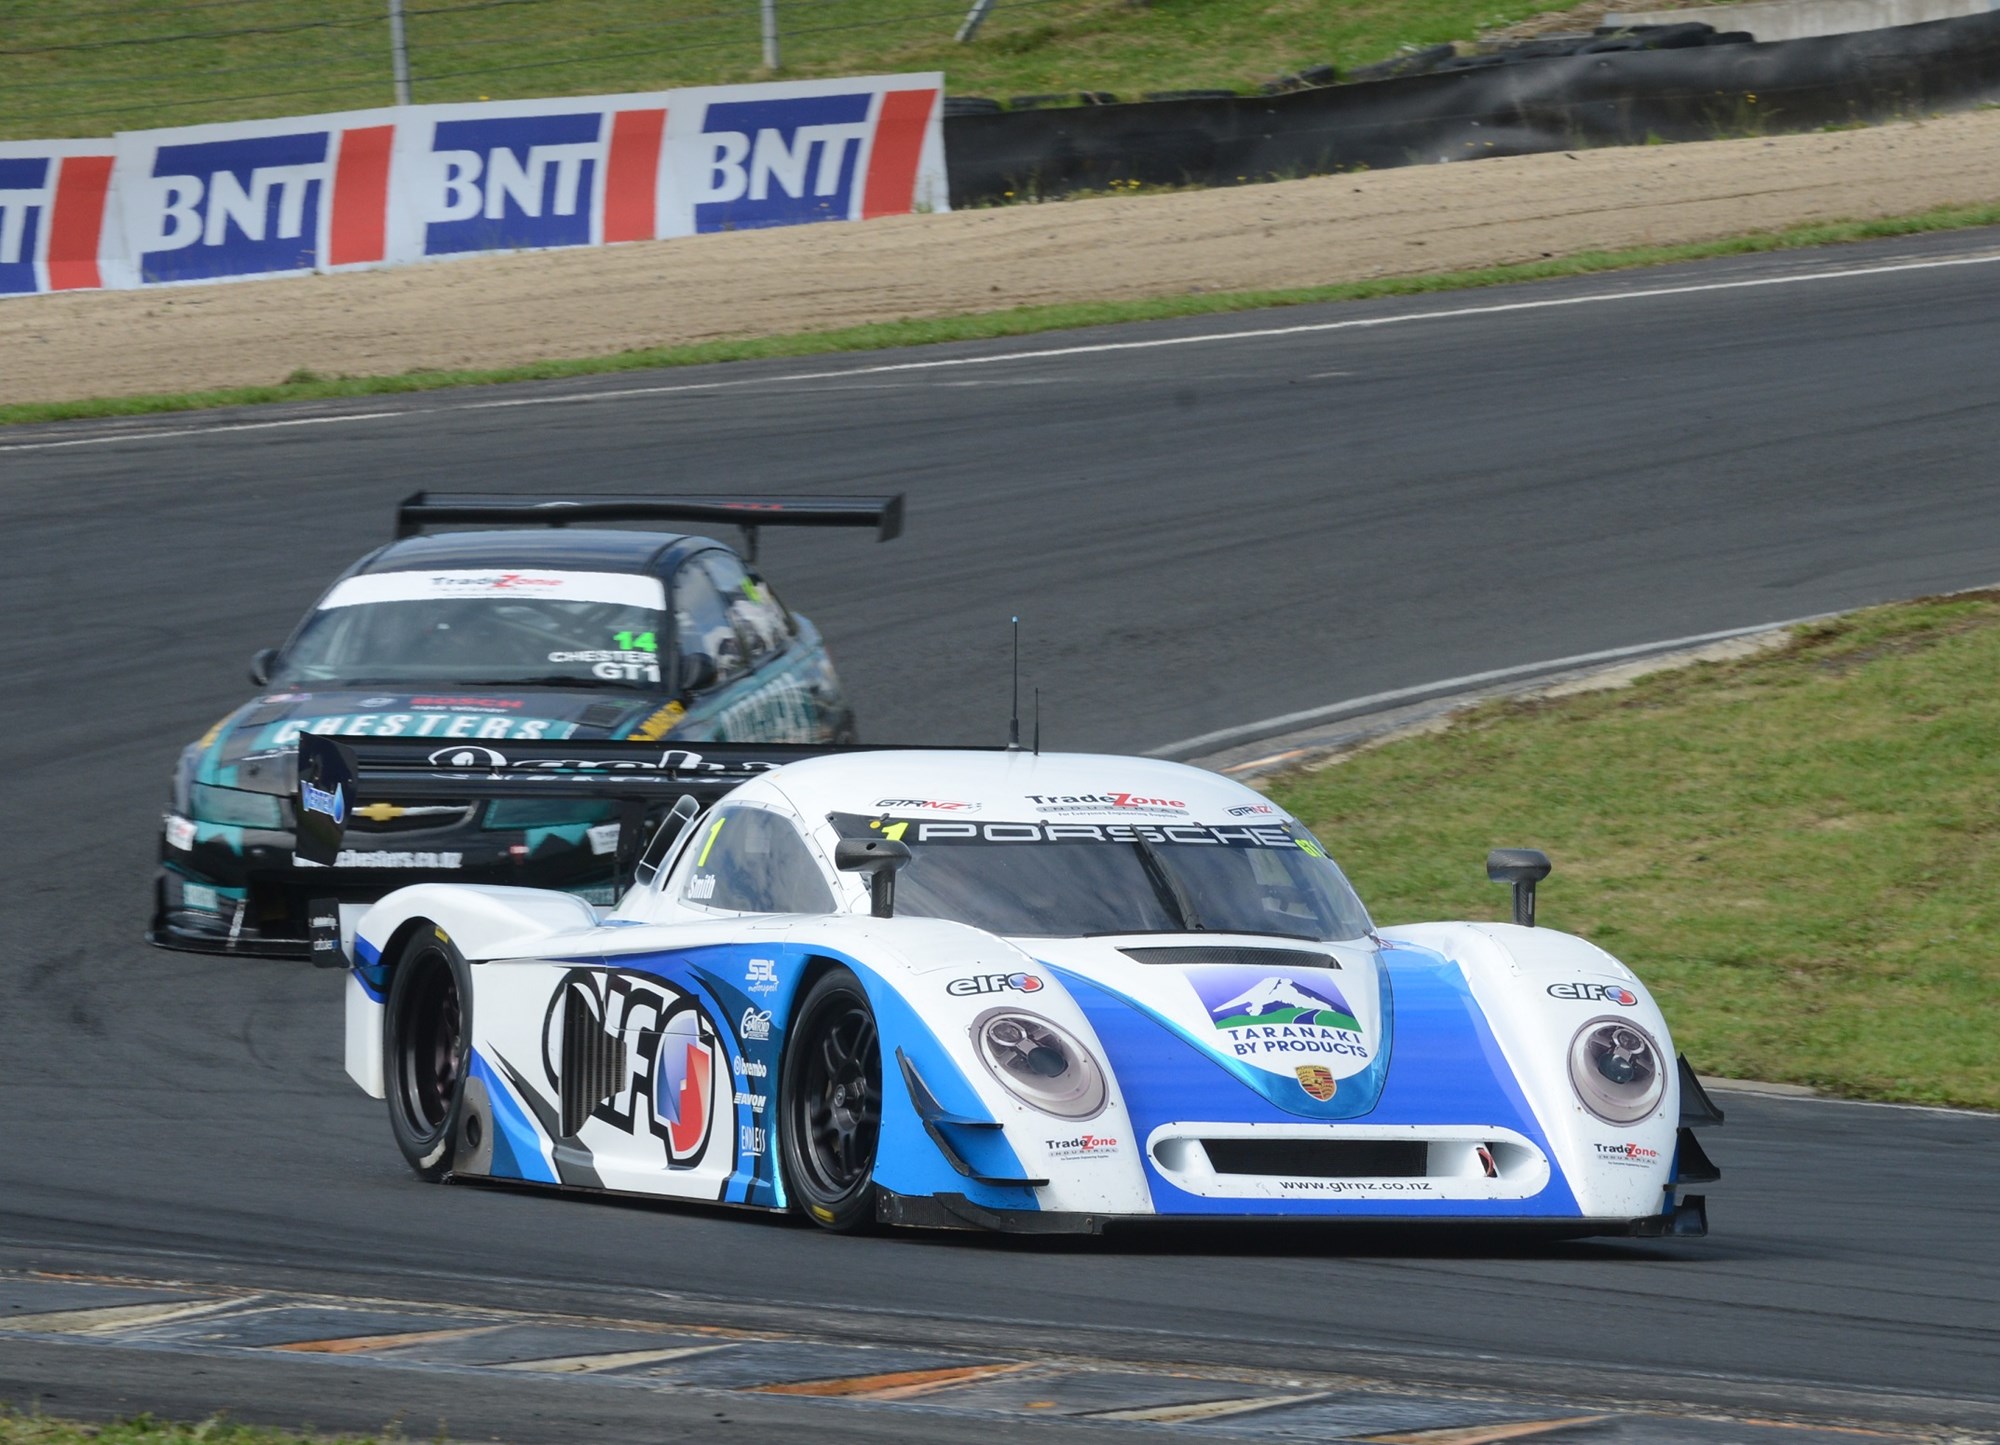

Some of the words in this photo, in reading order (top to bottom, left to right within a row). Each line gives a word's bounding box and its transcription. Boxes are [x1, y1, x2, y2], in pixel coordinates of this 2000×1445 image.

[697, 123, 866, 203] BNT
[427, 142, 598, 222] BNT
[143, 162, 324, 252] BNT
[613, 631, 658, 652] 14
[592, 662, 660, 682] GT1
[273, 714, 550, 743] CHESTERS
[875, 799, 964, 810] GTRNZ
[1025, 792, 1186, 808] TradeZone
[698, 817, 725, 867] 1
[918, 823, 1298, 847] PORSCHE
[688, 874, 715, 899] Smith
[1228, 1026, 1361, 1043] TARANAKI
[1234, 1042, 1256, 1055] BY
[1264, 1040, 1368, 1058] PRODUCTS
[741, 1058, 767, 1077] brembo
[741, 1094, 766, 1107] AVON
[742, 1126, 765, 1152] ENDLESS
[1045, 1135, 1117, 1150] TradeZone
[1594, 1143, 1657, 1157] TradeZone
[1280, 1181, 1432, 1192] www.gtrnz.co.nz
